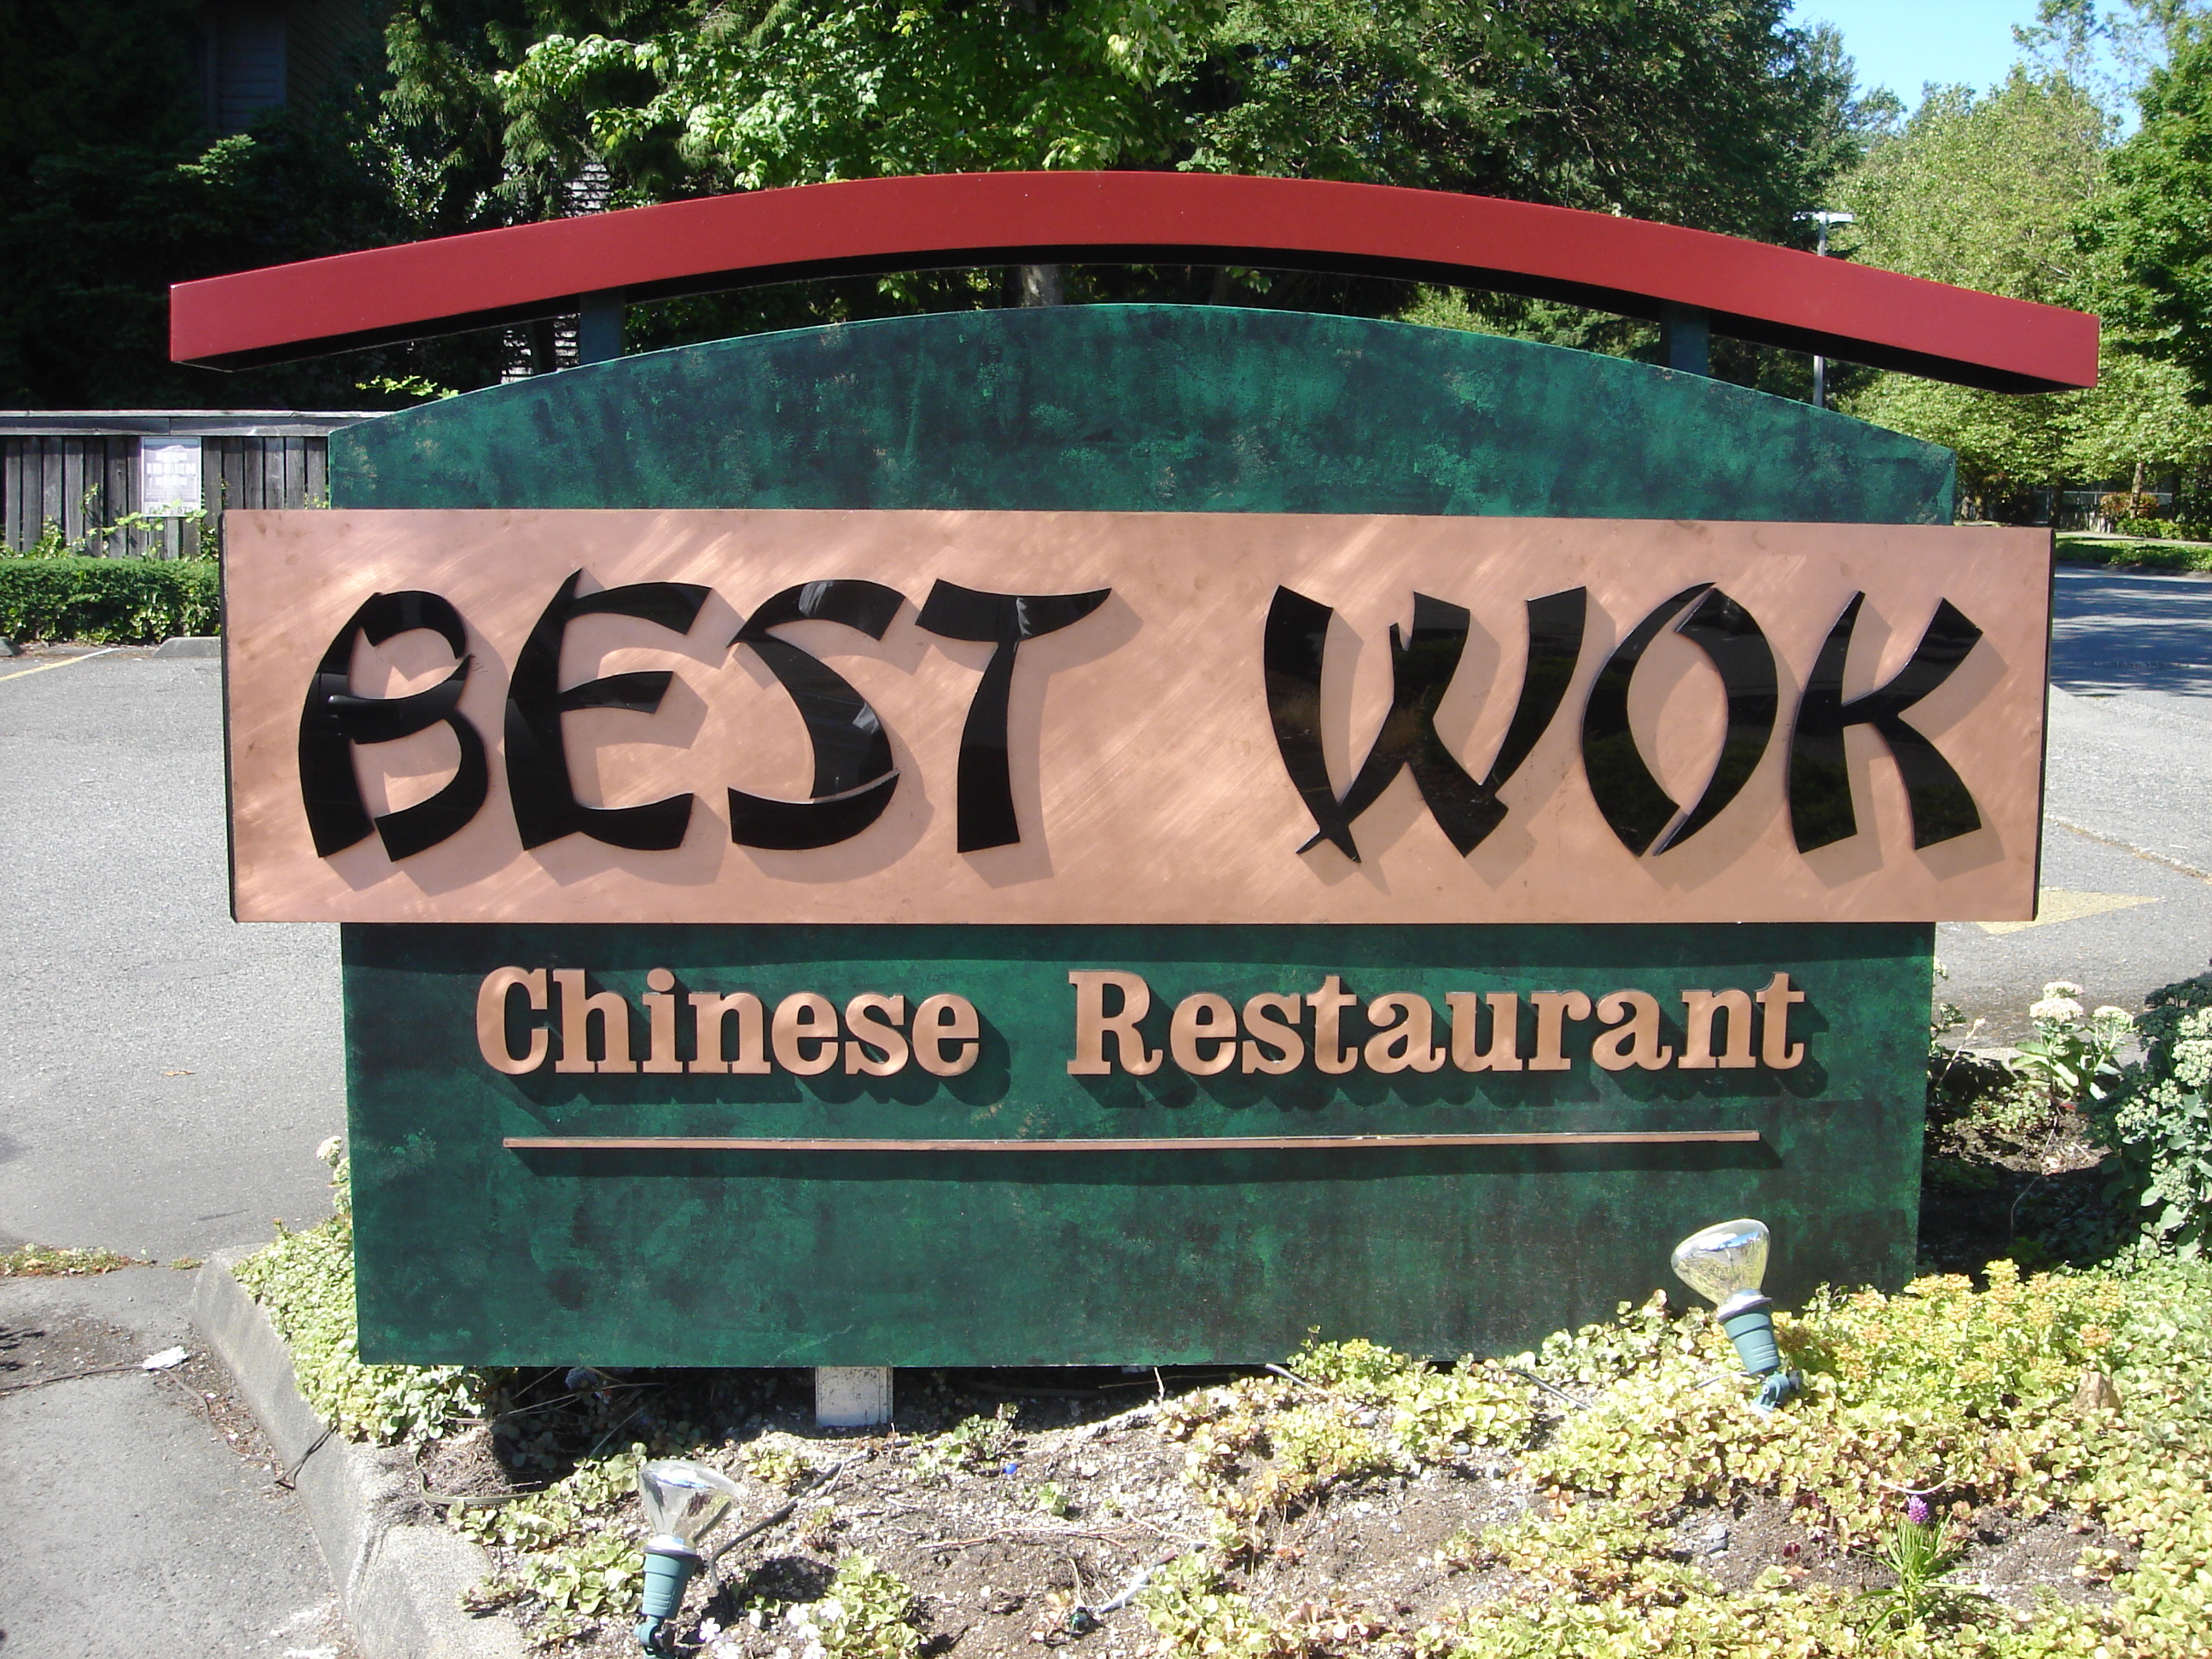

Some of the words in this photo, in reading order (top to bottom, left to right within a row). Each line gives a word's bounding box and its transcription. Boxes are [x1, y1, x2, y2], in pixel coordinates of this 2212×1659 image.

[299, 568, 1112, 862] BEST
[1264, 582, 1983, 864] WOK
[475, 965, 980, 1077] Chinese
[1067, 969, 1807, 1077] Restaurant
